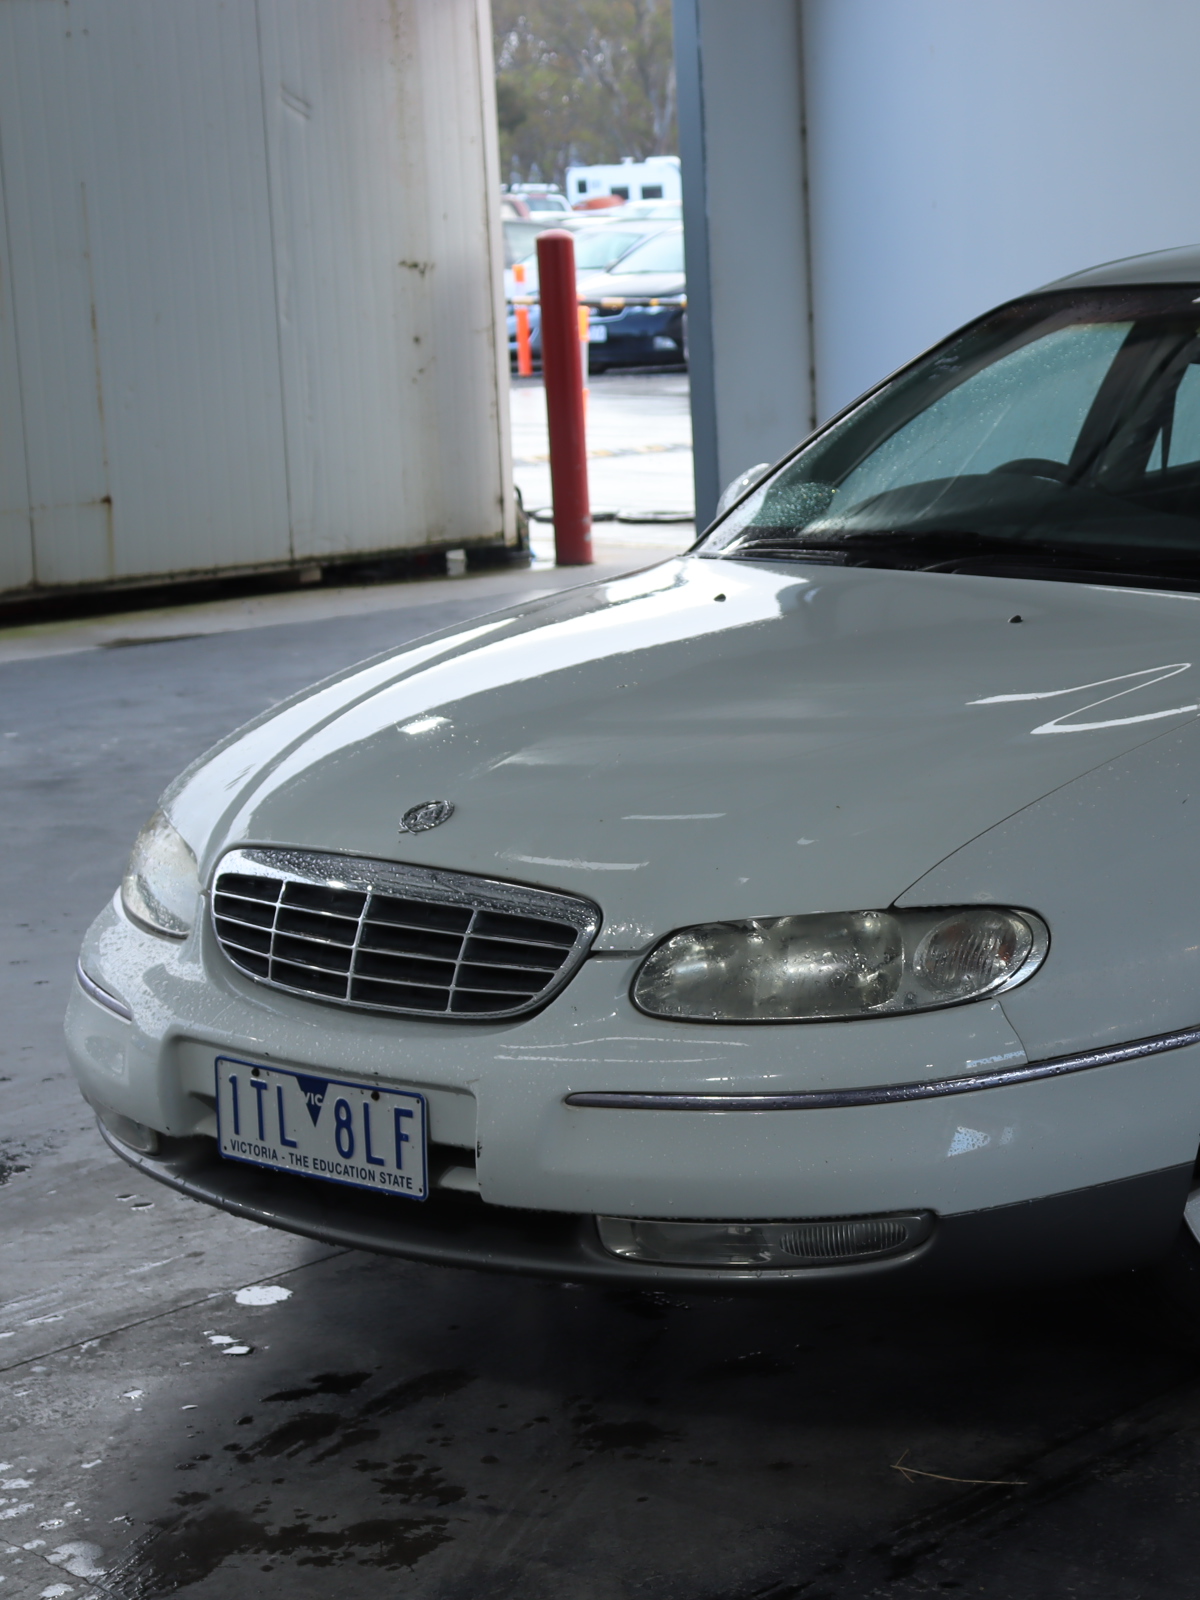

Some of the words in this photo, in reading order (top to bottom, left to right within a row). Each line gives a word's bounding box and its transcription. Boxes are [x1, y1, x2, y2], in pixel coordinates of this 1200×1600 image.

[229, 1074, 298, 1148] 1TL
[334, 1097, 413, 1170] 8LF
[305, 1092, 324, 1107] VIC
[230, 1139, 278, 1160] VICTORIA
[289, 1152, 309, 1168] THE
[312, 1158, 376, 1182] EDUCATION
[379, 1171, 413, 1190] STATE
